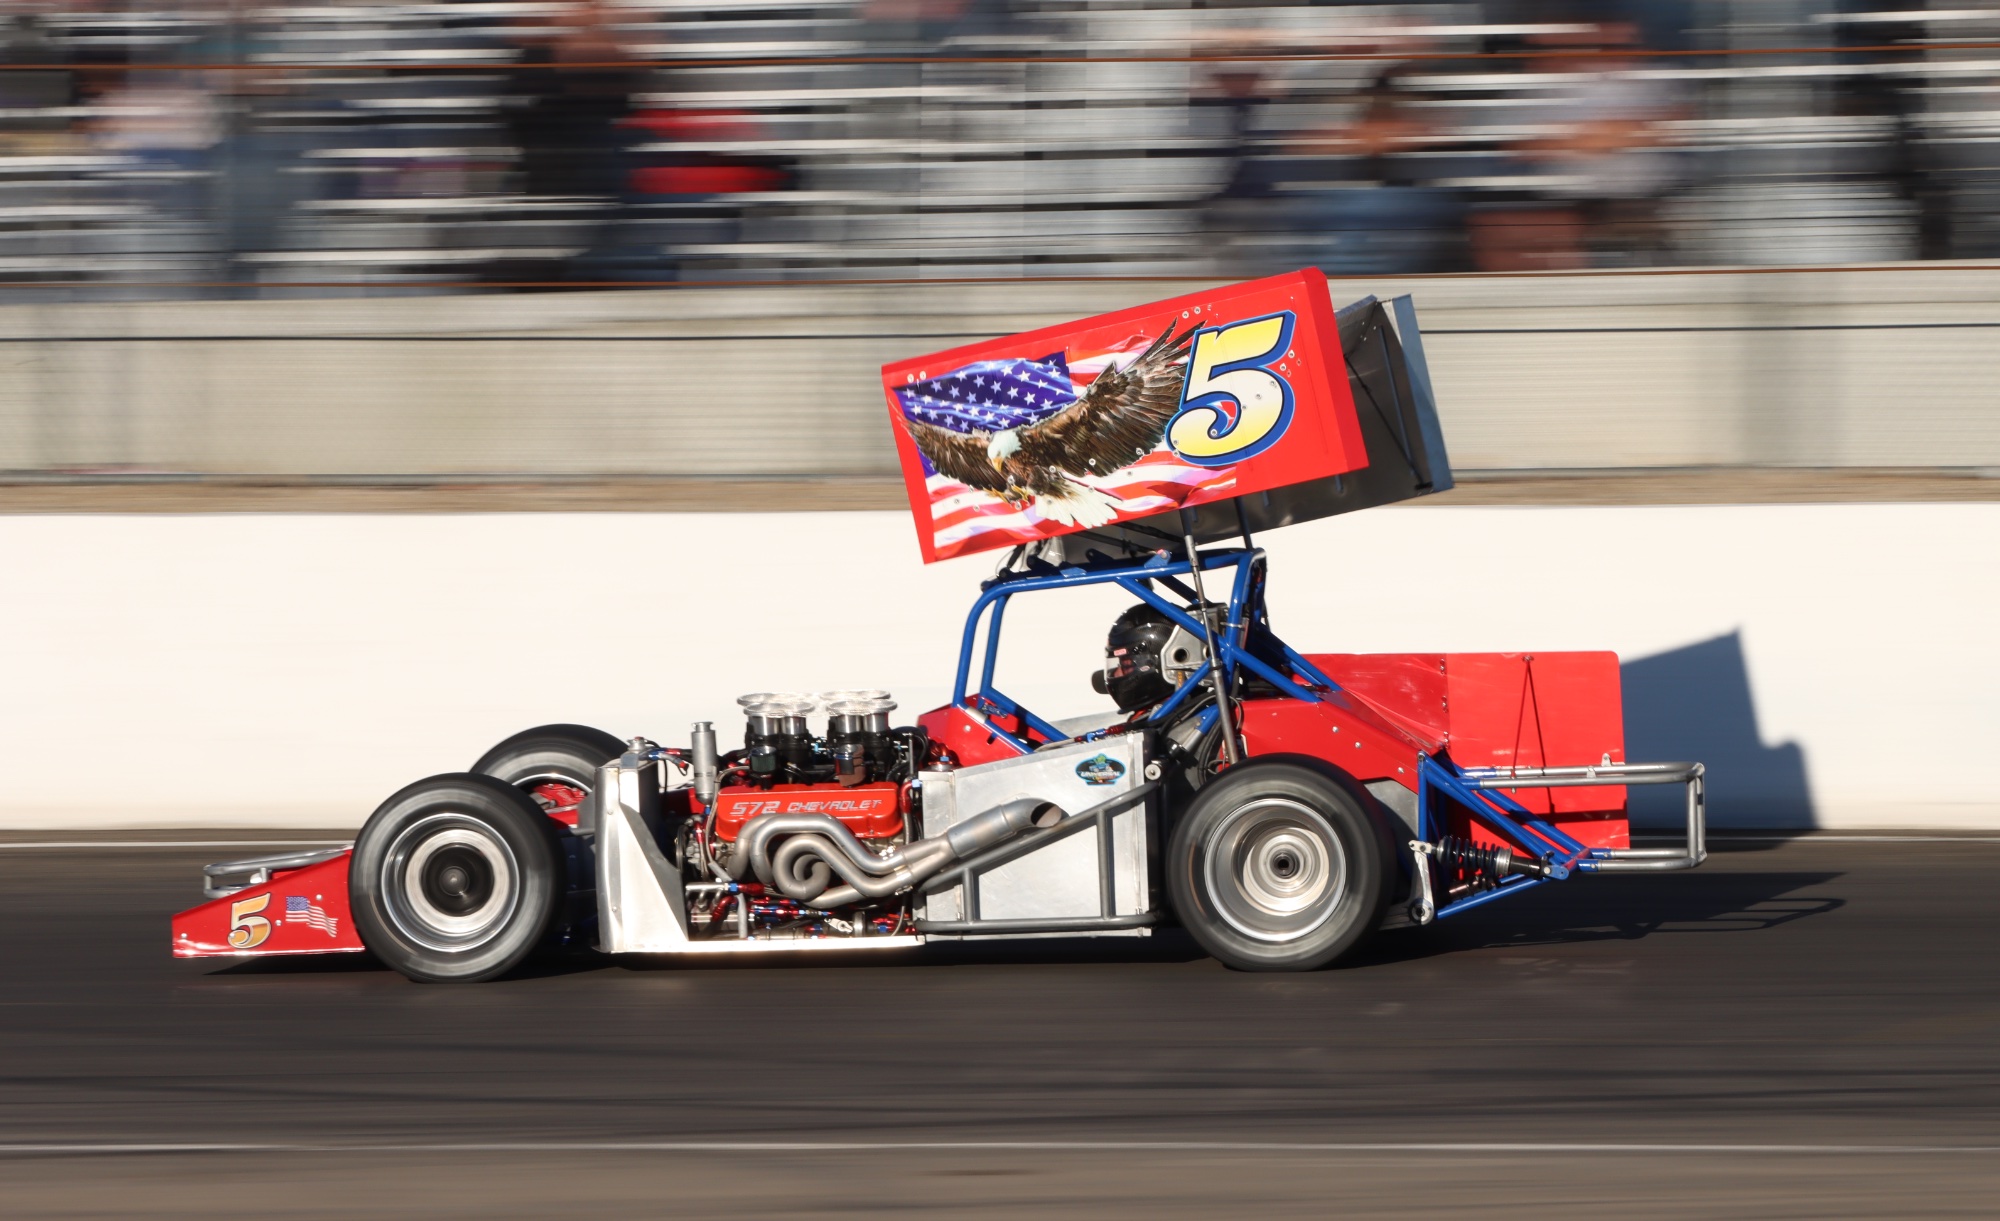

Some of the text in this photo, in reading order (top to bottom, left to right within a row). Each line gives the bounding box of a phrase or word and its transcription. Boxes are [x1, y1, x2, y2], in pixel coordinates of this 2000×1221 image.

[1166, 310, 1297, 466] 5
[730, 800, 882, 815] 572 CHEVROLET
[227, 892, 272, 949] 5
